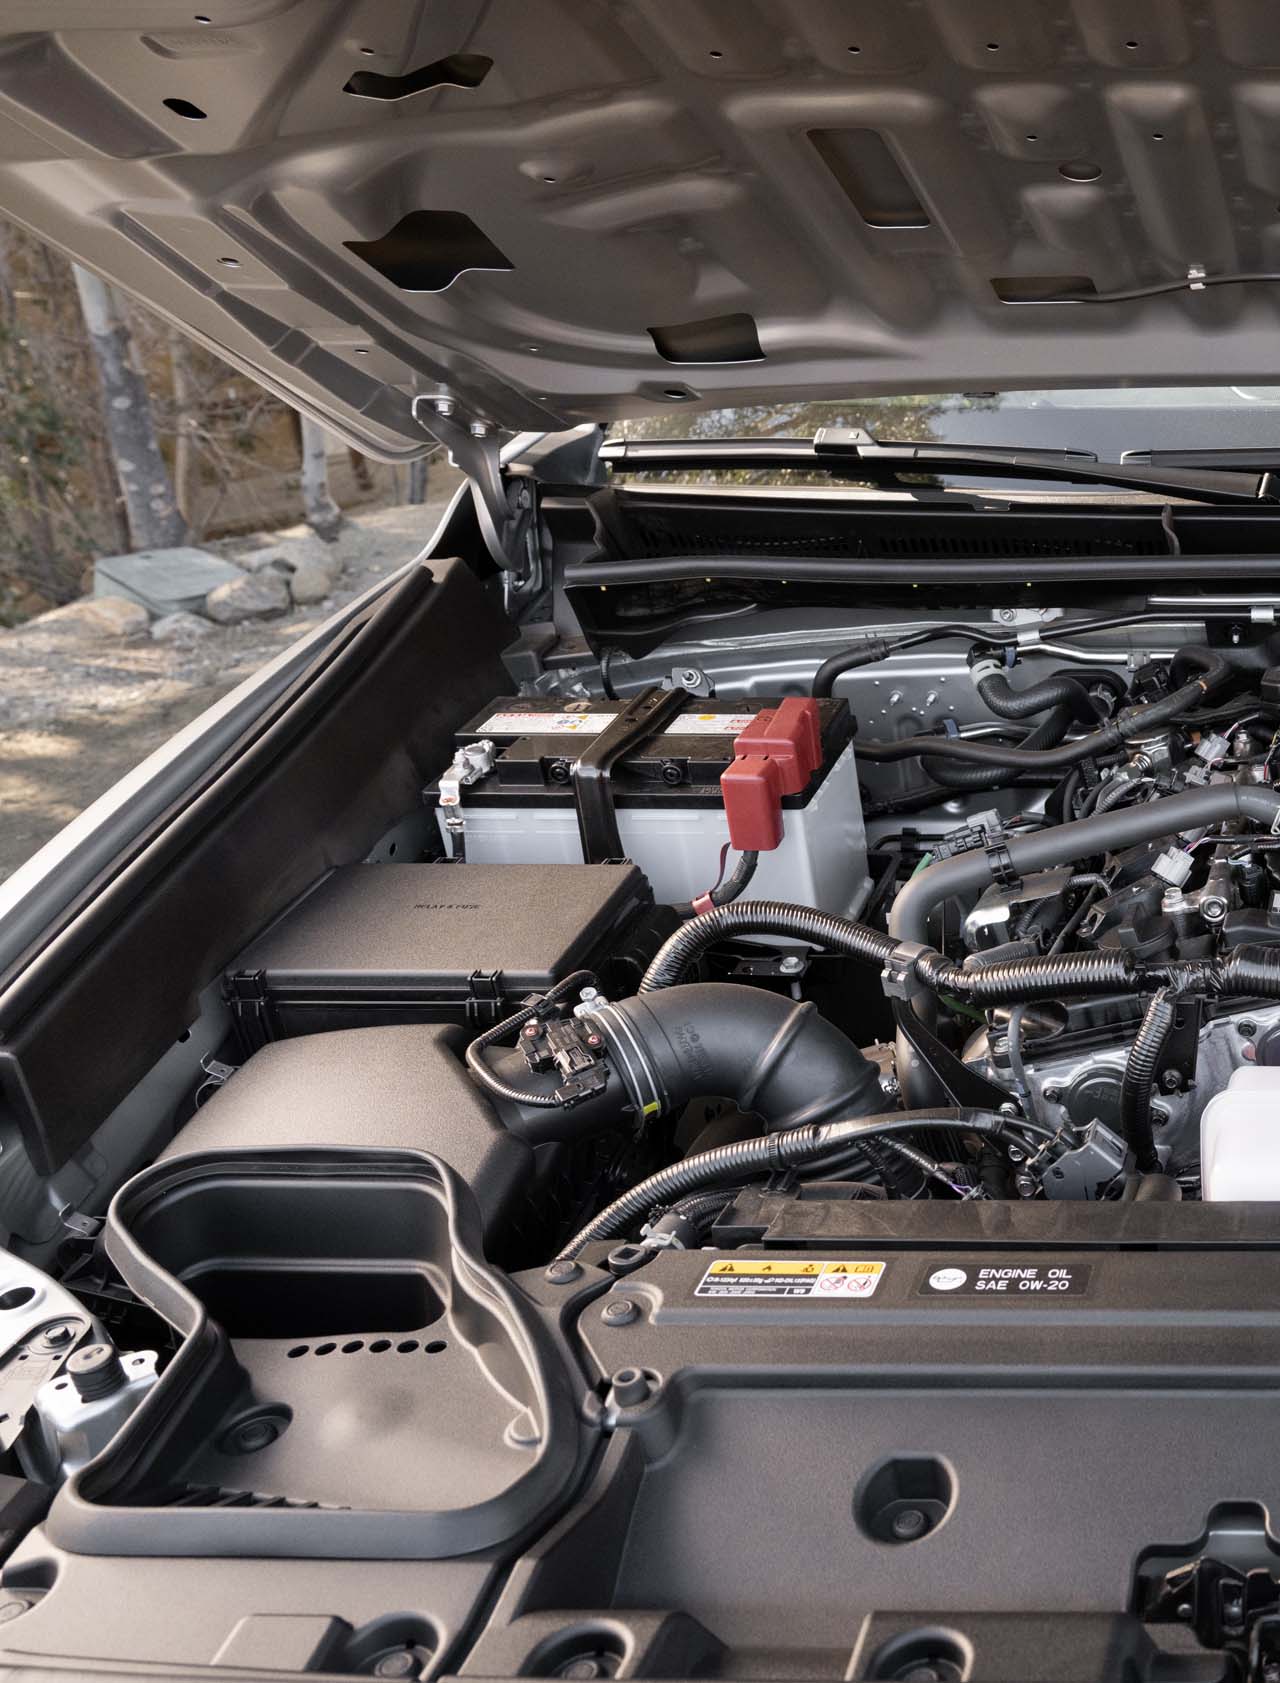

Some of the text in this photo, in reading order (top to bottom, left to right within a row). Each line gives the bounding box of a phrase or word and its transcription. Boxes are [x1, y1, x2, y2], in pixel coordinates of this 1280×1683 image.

[978, 1268, 1073, 1279] ENGINE OIL
[975, 1280, 1070, 1290] SAE 0W-20
